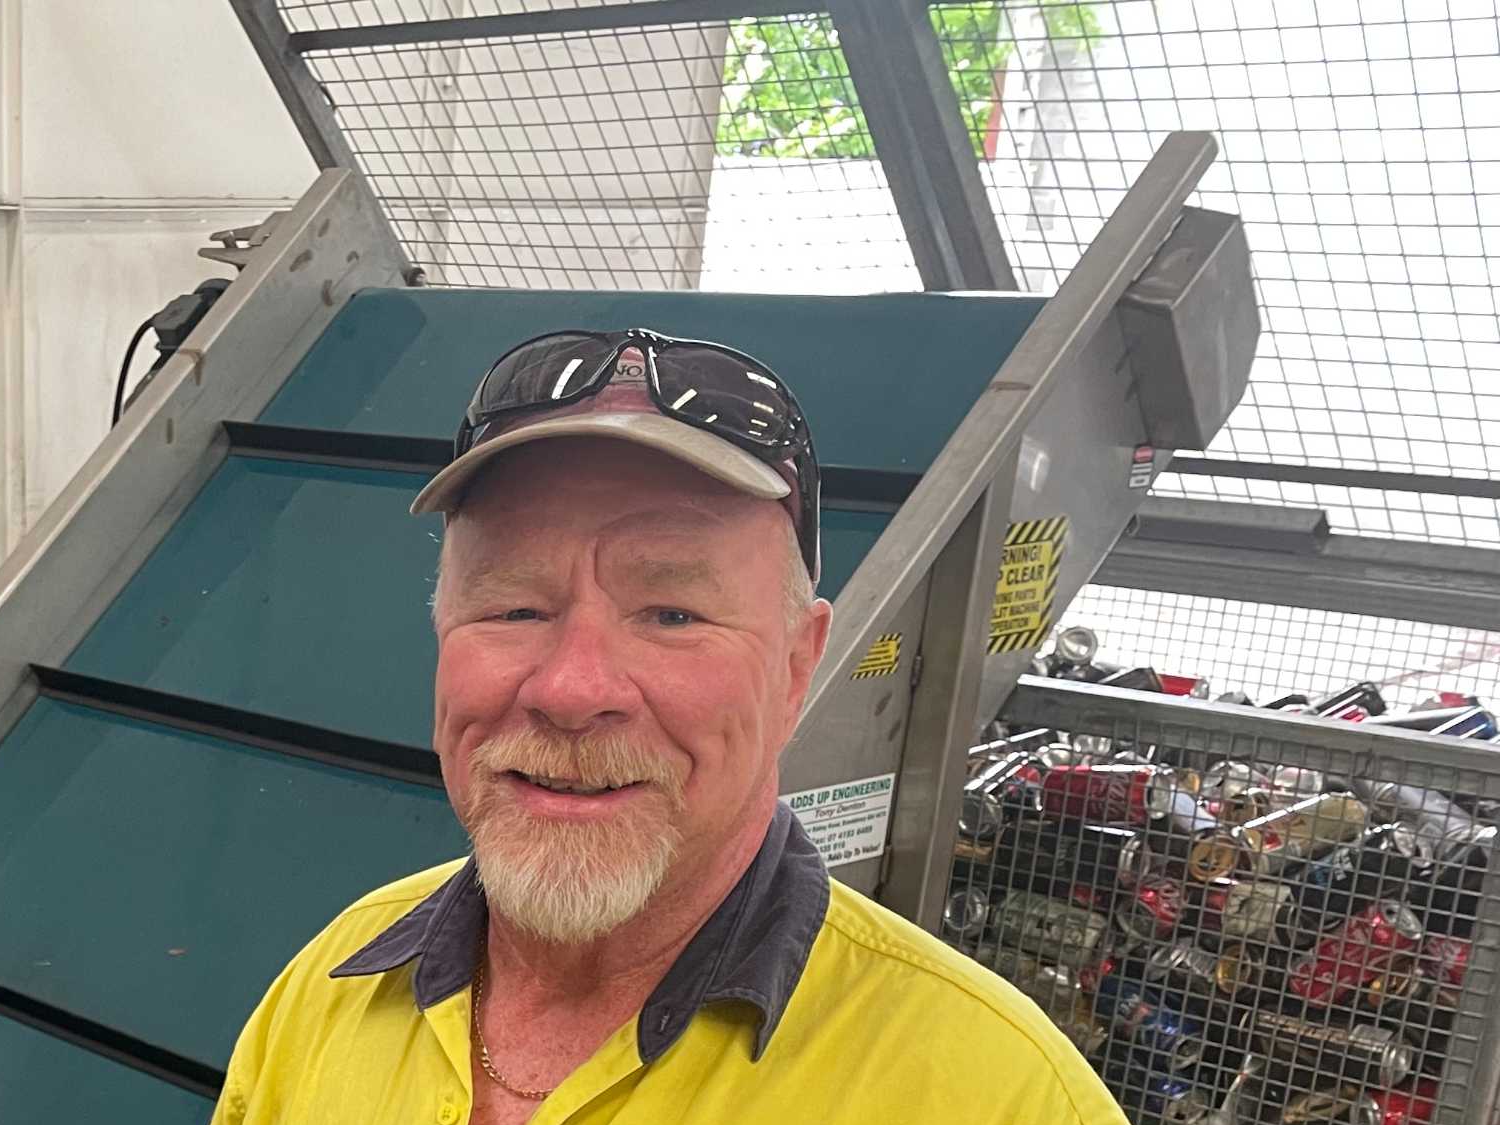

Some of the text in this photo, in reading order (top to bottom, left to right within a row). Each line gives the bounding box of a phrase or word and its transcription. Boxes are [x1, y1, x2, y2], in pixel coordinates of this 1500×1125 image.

[1006, 564, 1045, 586] CLEAR
[817, 791, 830, 804] UP
[832, 778, 891, 801] ENGINEERING
